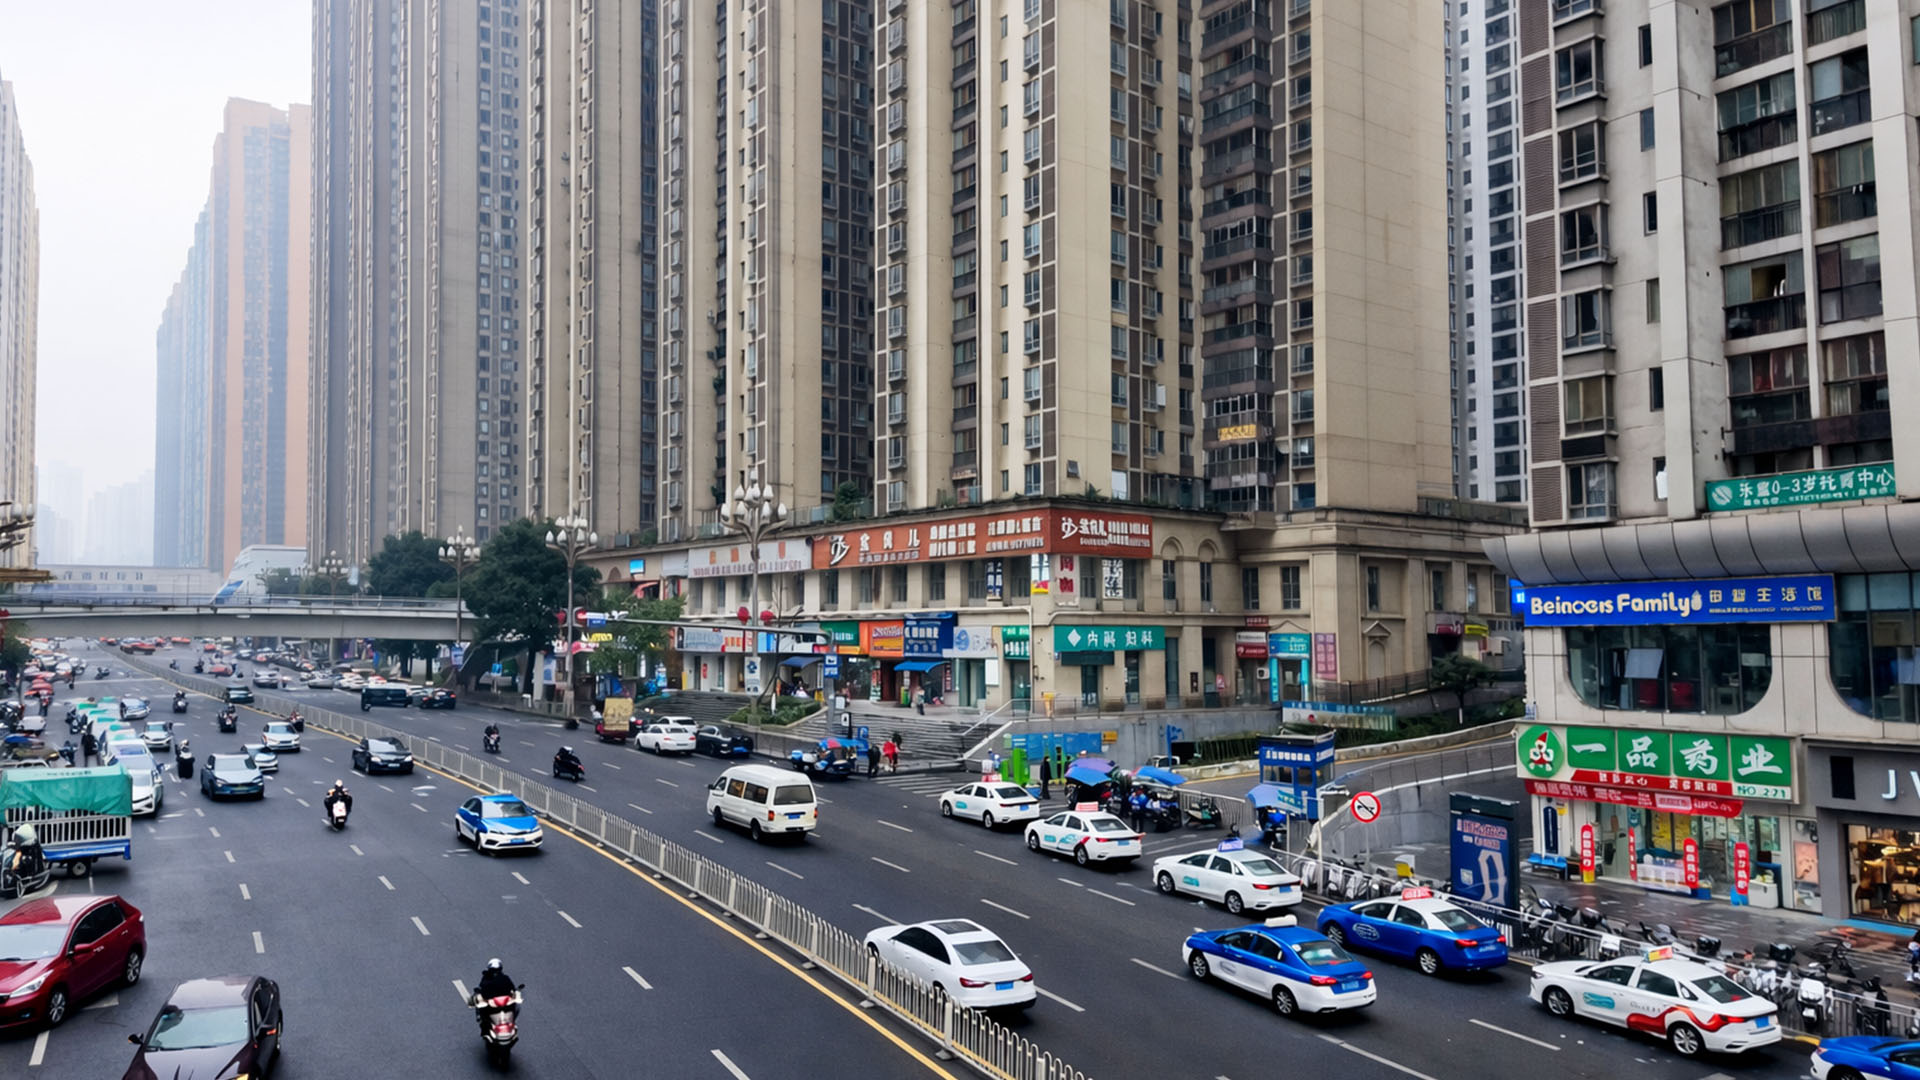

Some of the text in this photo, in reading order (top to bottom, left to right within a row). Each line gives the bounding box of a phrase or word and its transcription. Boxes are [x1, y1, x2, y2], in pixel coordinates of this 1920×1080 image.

[1617, 591, 1690, 617] Family
[1571, 735, 1784, 776] 一品药业
